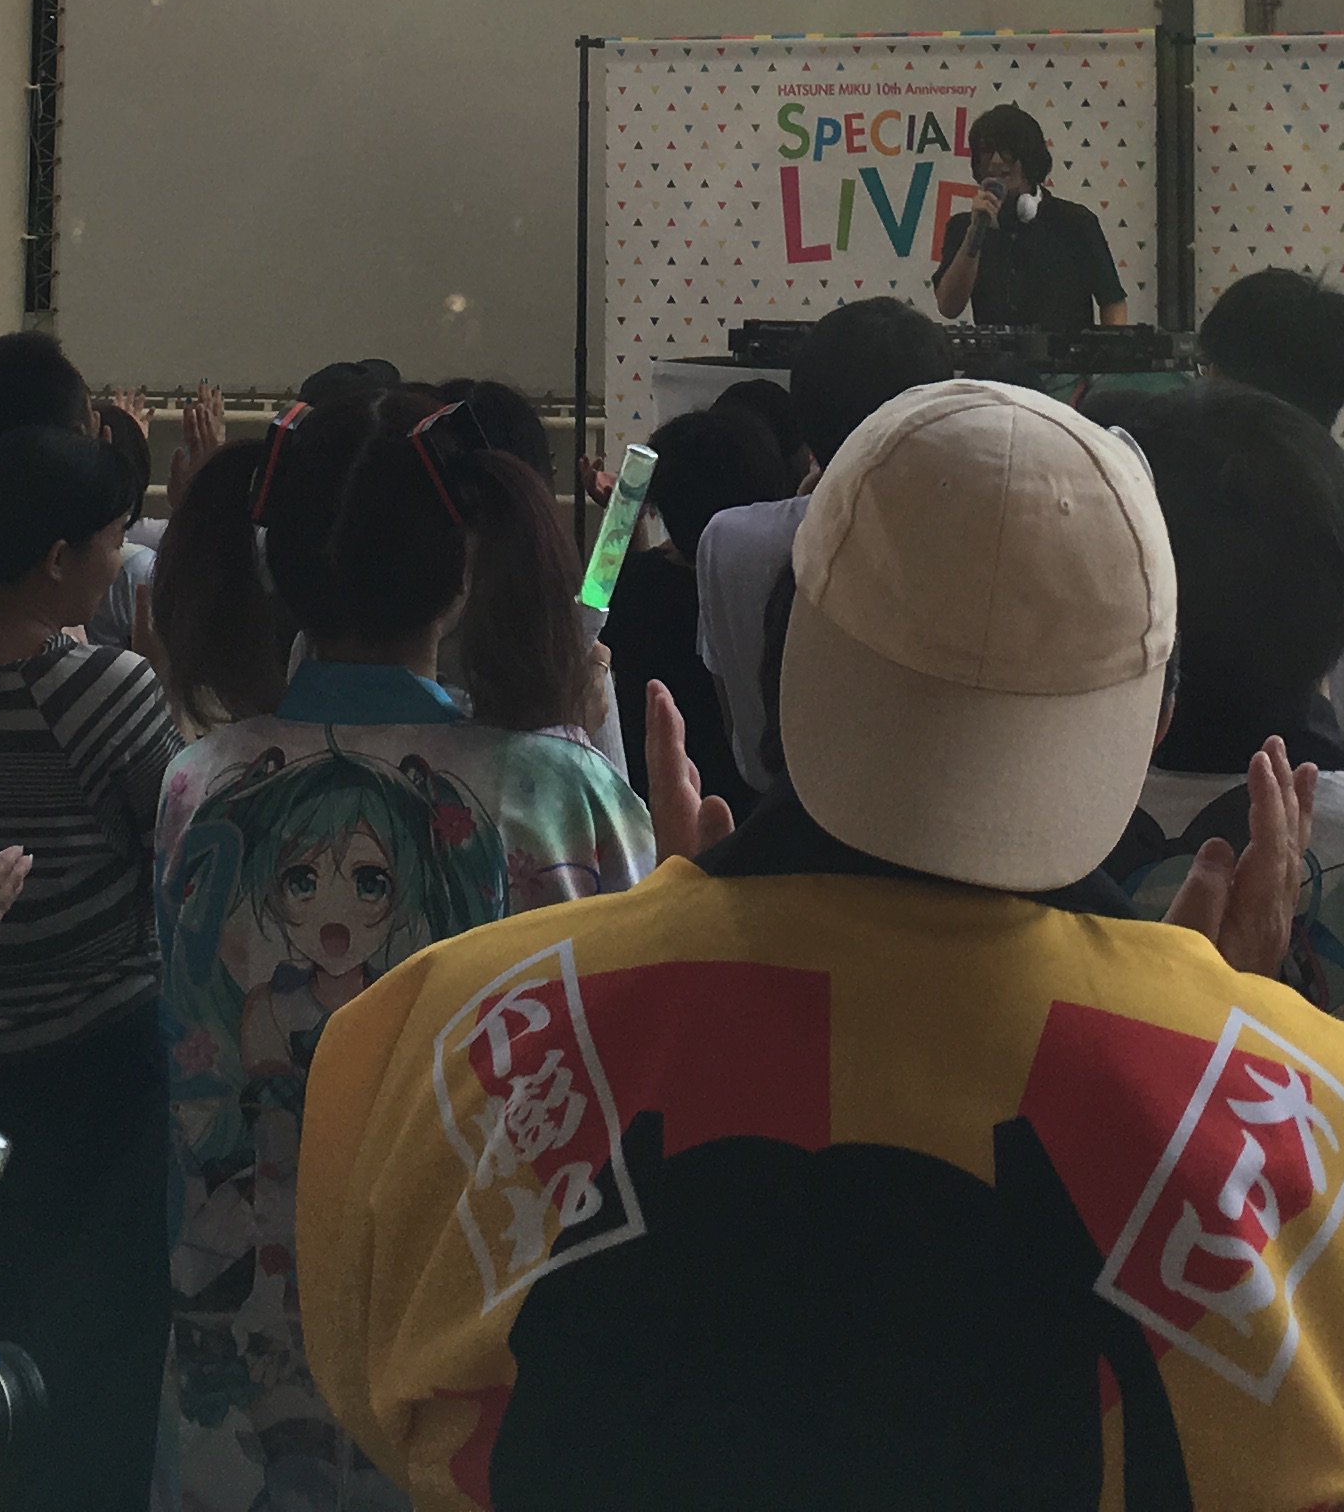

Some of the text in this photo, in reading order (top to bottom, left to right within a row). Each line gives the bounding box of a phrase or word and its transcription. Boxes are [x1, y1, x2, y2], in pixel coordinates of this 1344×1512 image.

[777, 82, 977, 98] HATSUNE MIKU 10th Anniversary
[777, 102, 973, 162] SPECIAL
